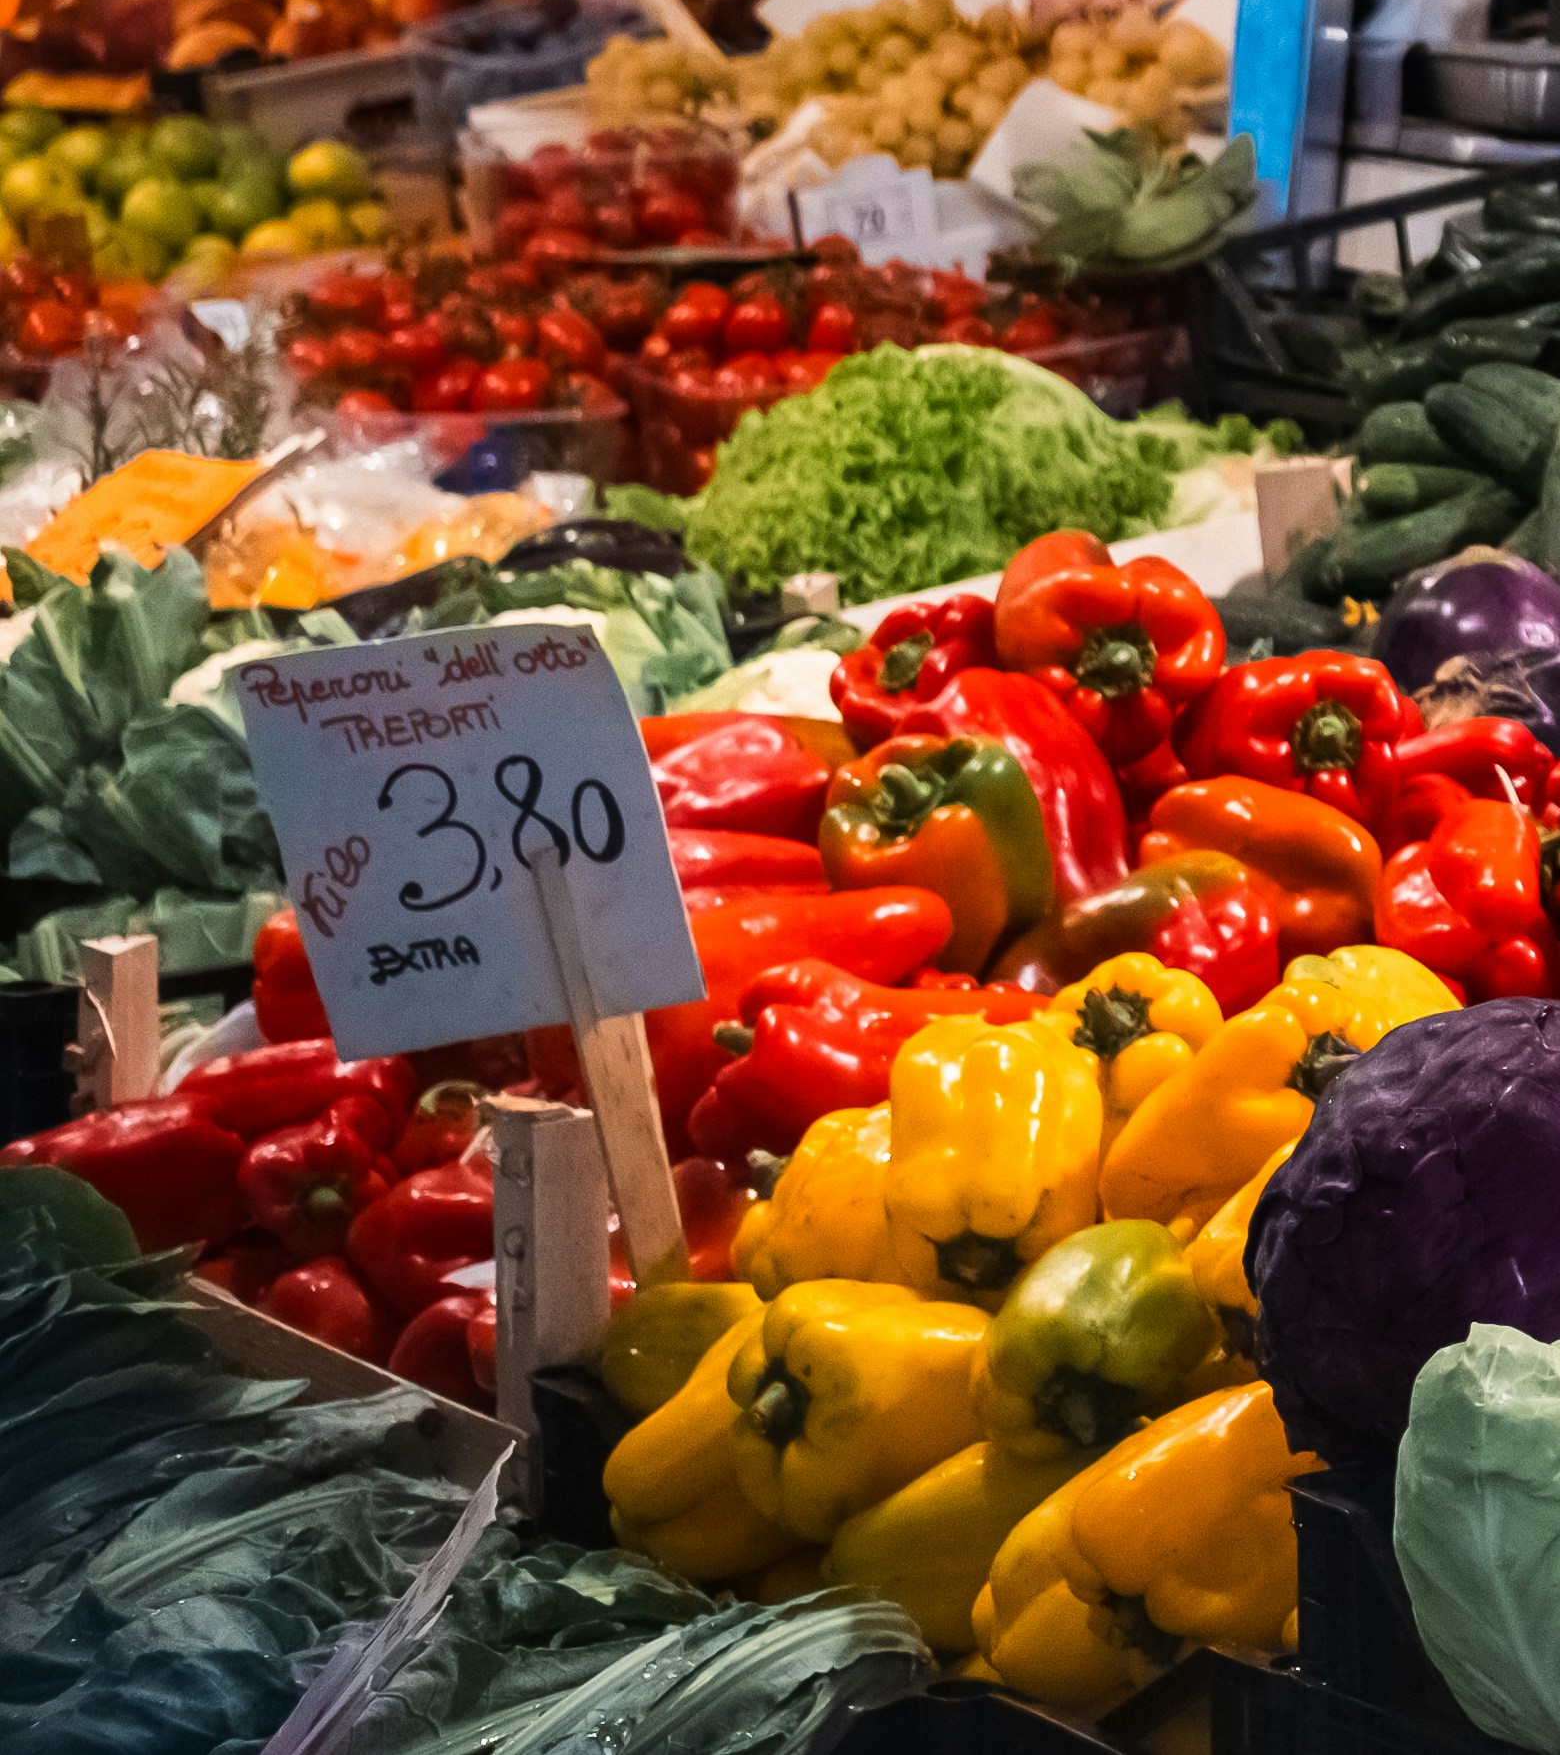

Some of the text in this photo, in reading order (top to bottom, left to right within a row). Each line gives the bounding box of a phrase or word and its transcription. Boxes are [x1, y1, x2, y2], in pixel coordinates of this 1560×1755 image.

[239, 660, 412, 723] Peperoni
[376, 754, 626, 913] 3,80
[367, 935, 481, 986] EXTRA
